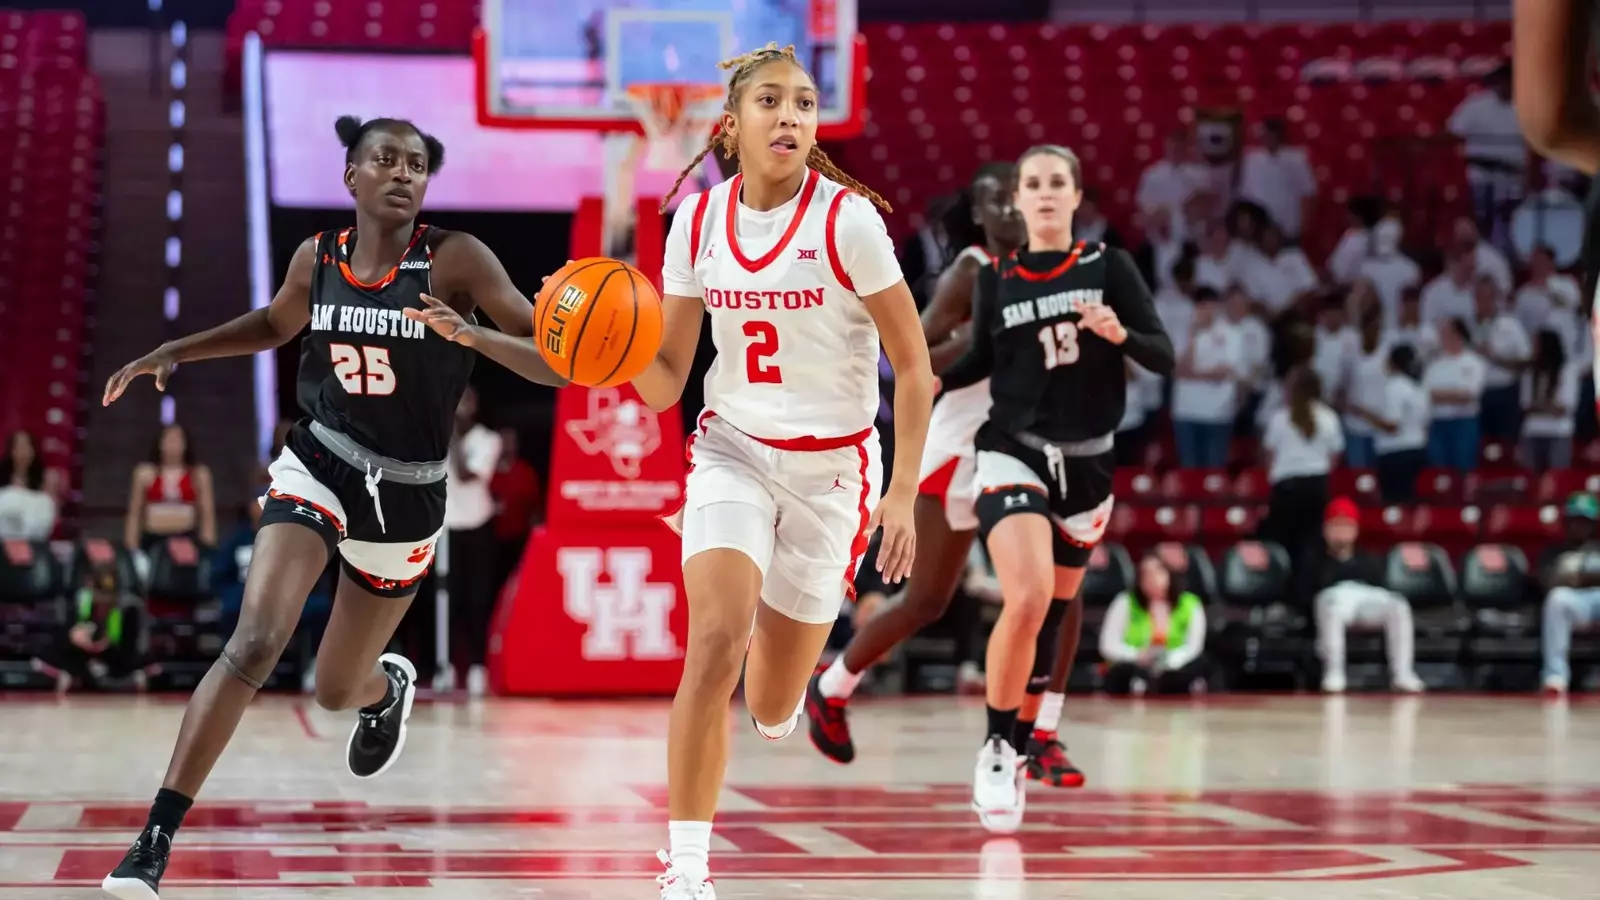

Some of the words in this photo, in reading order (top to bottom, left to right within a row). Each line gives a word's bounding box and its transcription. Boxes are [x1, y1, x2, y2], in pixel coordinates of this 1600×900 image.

[311, 304, 335, 330] AM
[338, 305, 425, 339] HOUSTON
[547, 284, 583, 356] ELITE
[1002, 300, 1036, 328] SAM
[329, 343, 396, 395] 25
[742, 321, 783, 383] 2
[1038, 321, 1080, 370] 13
